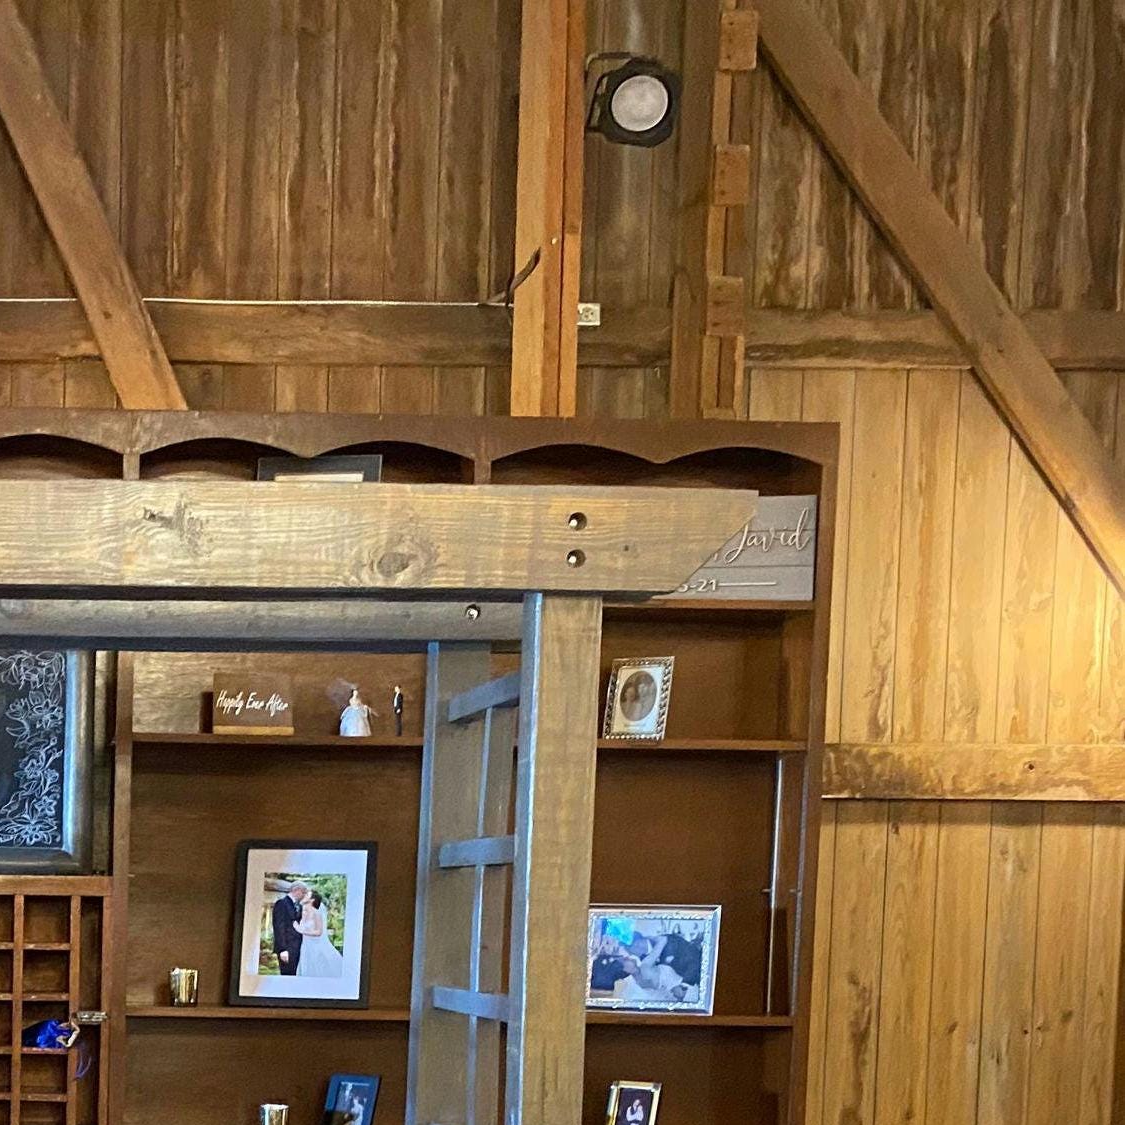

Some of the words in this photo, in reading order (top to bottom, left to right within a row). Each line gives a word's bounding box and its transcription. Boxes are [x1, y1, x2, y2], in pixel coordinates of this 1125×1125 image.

[215, 690, 244, 715] Happily
[245, 692, 265, 710] Ever
[264, 693, 289, 717] After
